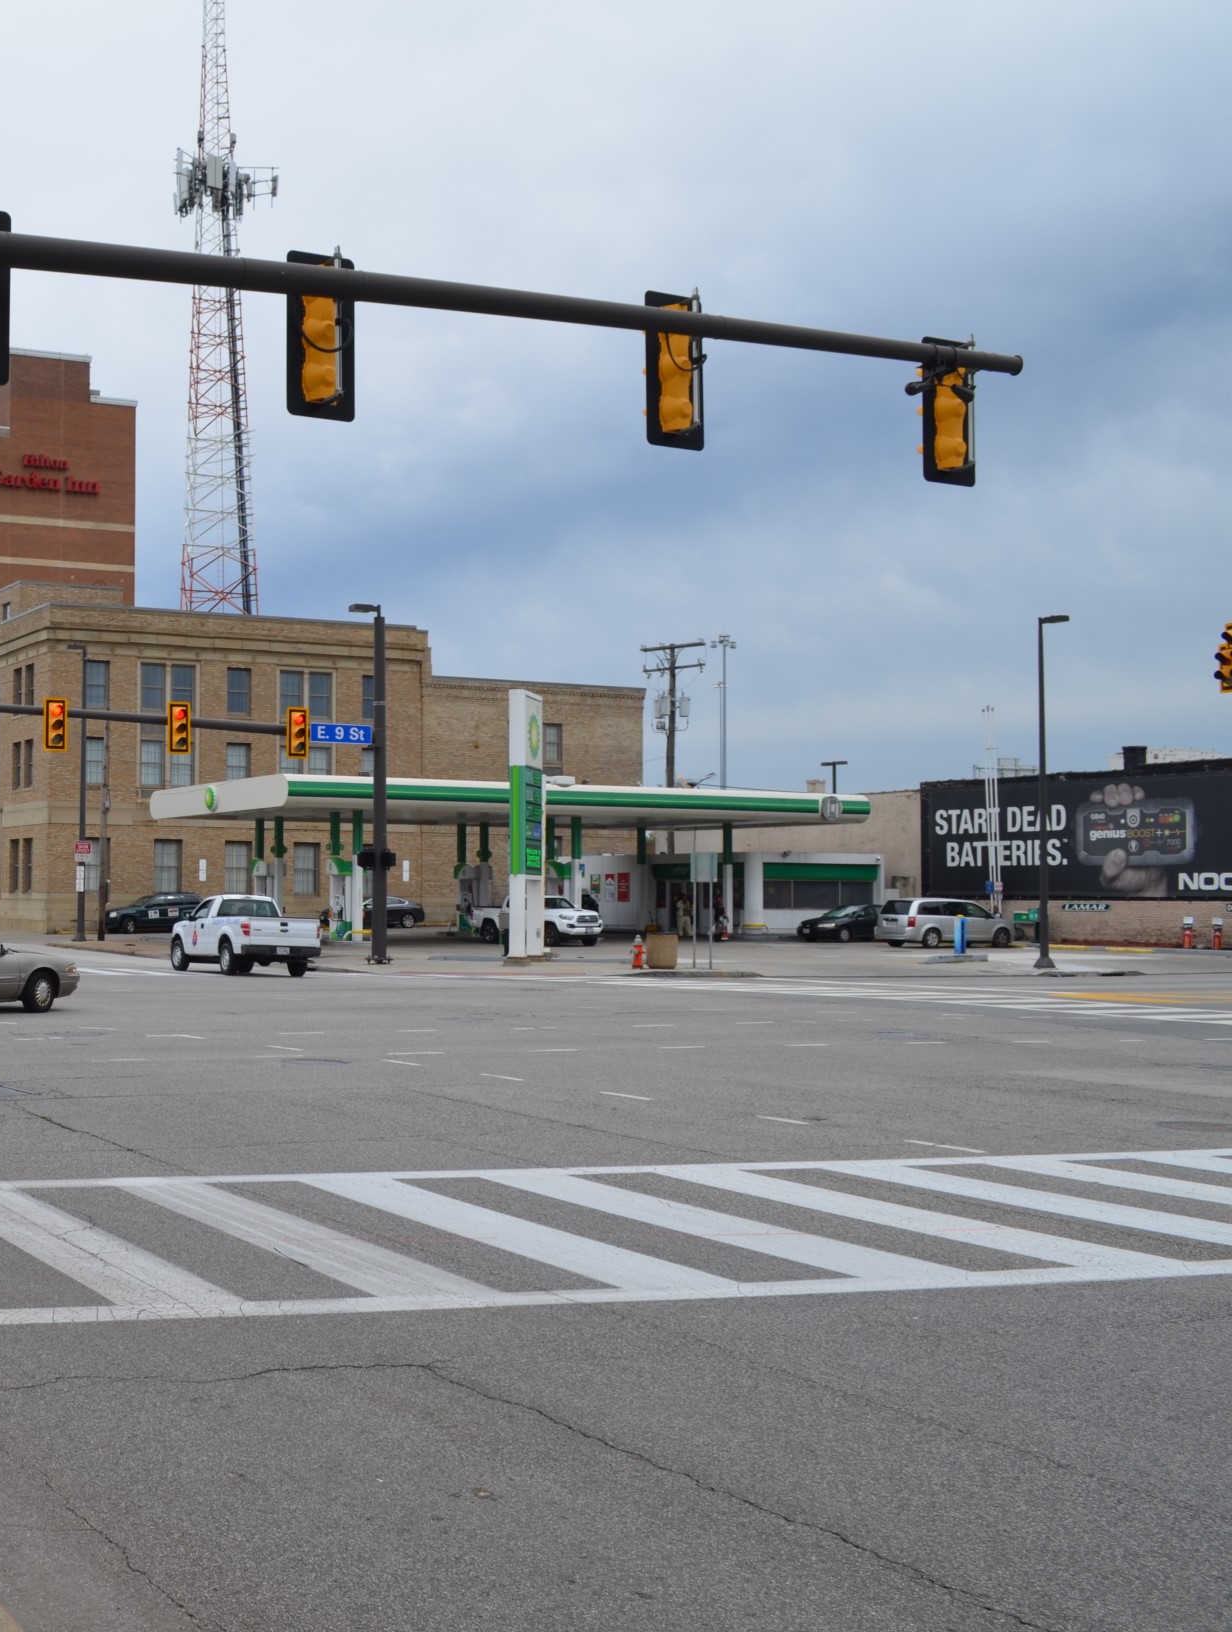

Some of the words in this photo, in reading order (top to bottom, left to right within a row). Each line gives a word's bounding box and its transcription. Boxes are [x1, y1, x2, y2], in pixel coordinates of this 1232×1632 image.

[66, 475, 100, 496] Inn
[317, 725, 329, 739] E.
[335, 726, 345, 740] 9
[349, 727, 365, 741] St
[935, 808, 1000, 835] START
[1006, 804, 1067, 833] DEAD
[1089, 828, 1126, 841] genius
